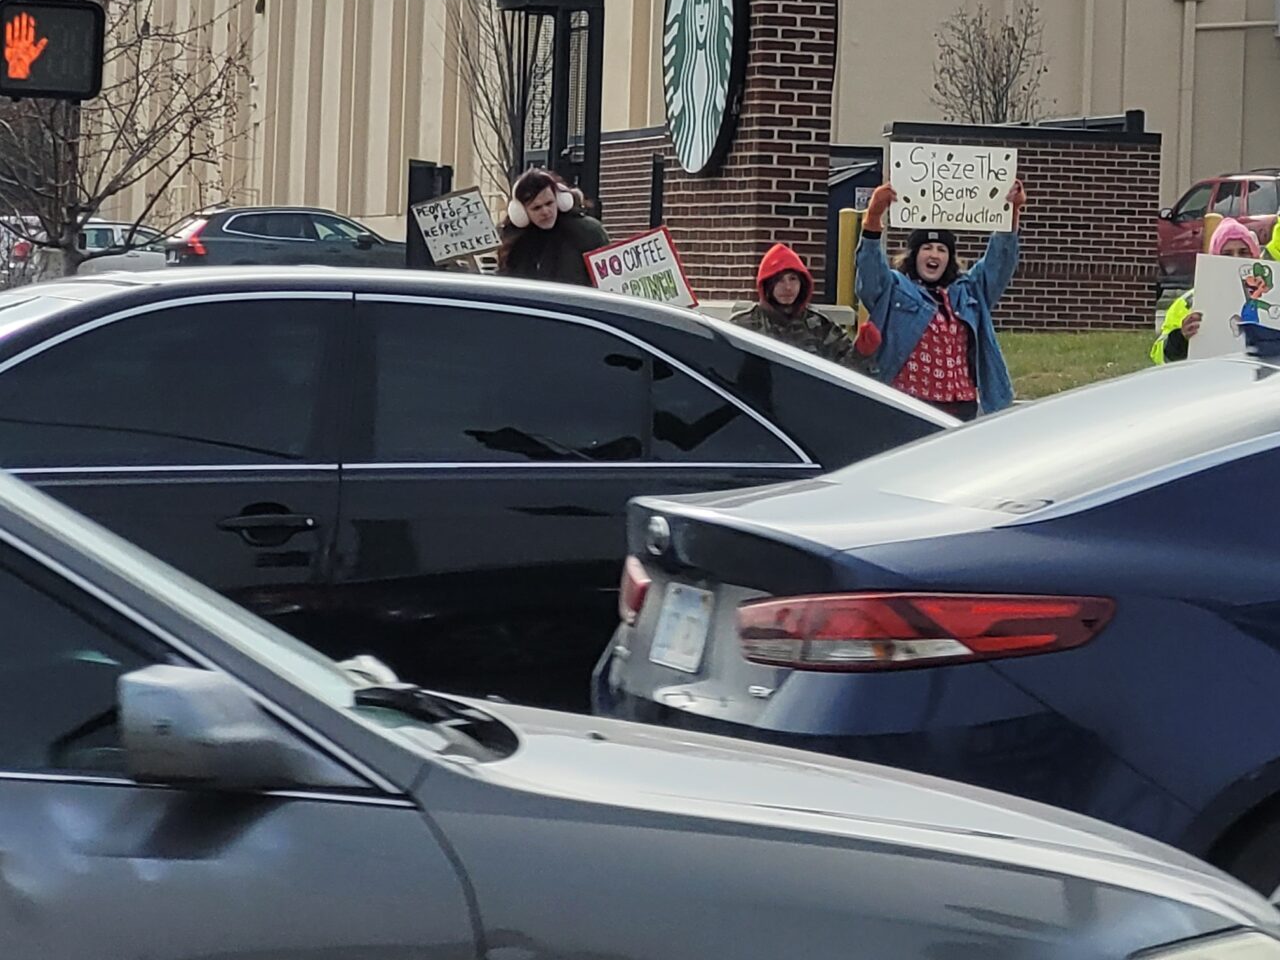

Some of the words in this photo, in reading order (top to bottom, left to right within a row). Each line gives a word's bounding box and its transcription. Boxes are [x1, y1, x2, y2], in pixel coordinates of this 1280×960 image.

[909, 146, 975, 183] Sieze
[975, 152, 1008, 182] The
[932, 180, 980, 202] Beans
[416, 199, 453, 218] PEOPLE
[433, 201, 482, 223] PROFIT
[931, 203, 1003, 225] Production
[423, 217, 470, 238] RESPECT
[444, 230, 500, 255] STRIKE!
[594, 254, 623, 280] NO
[622, 237, 667, 272] COFFEE
